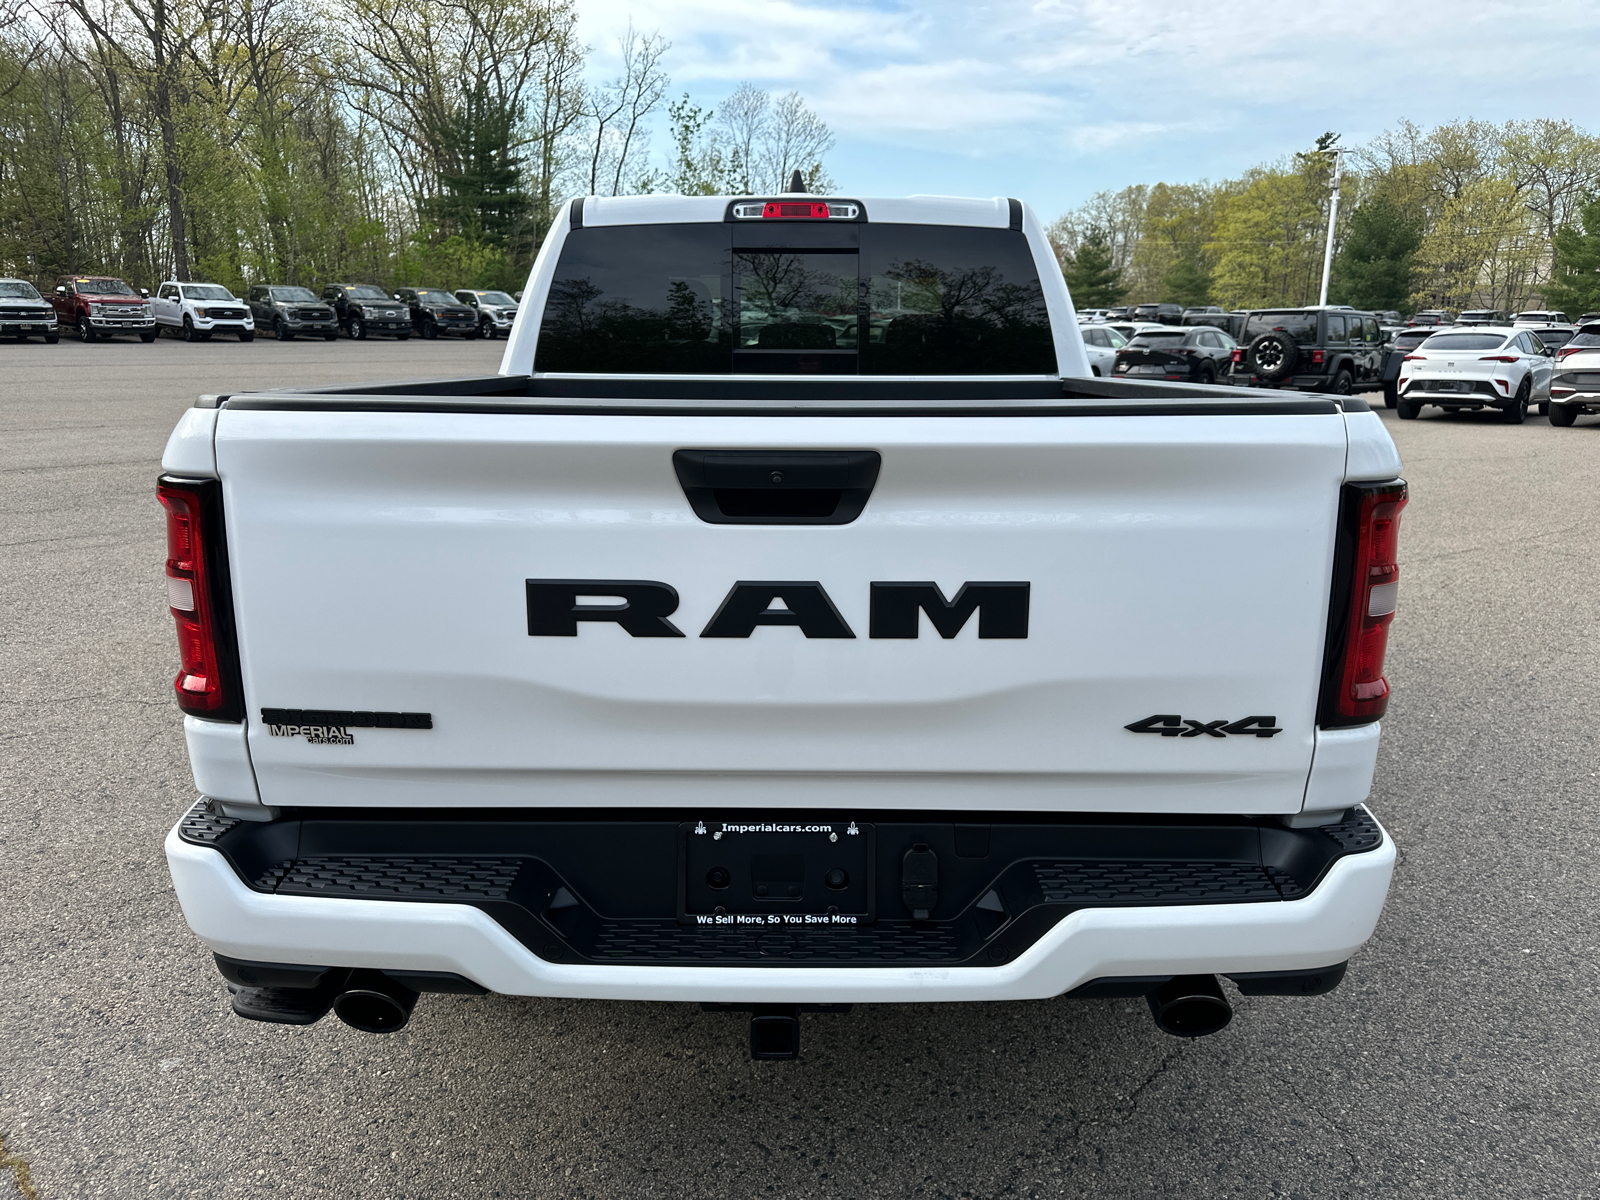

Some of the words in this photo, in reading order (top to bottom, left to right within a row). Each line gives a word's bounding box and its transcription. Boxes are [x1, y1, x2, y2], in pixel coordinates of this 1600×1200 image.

[526, 578, 1030, 639] RAM
[268, 724, 352, 738] IMPERIAL
[1124, 714, 1283, 738] 4x4
[306, 736, 353, 745] cars.com
[722, 823, 832, 833] Imperialcars.com
[697, 915, 713, 924] We
[715, 914, 734, 924] Sell
[737, 915, 765, 925] More,
[767, 914, 780, 924] So
[783, 915, 802, 924] You
[804, 914, 829, 924] Save
[832, 915, 857, 924] More
